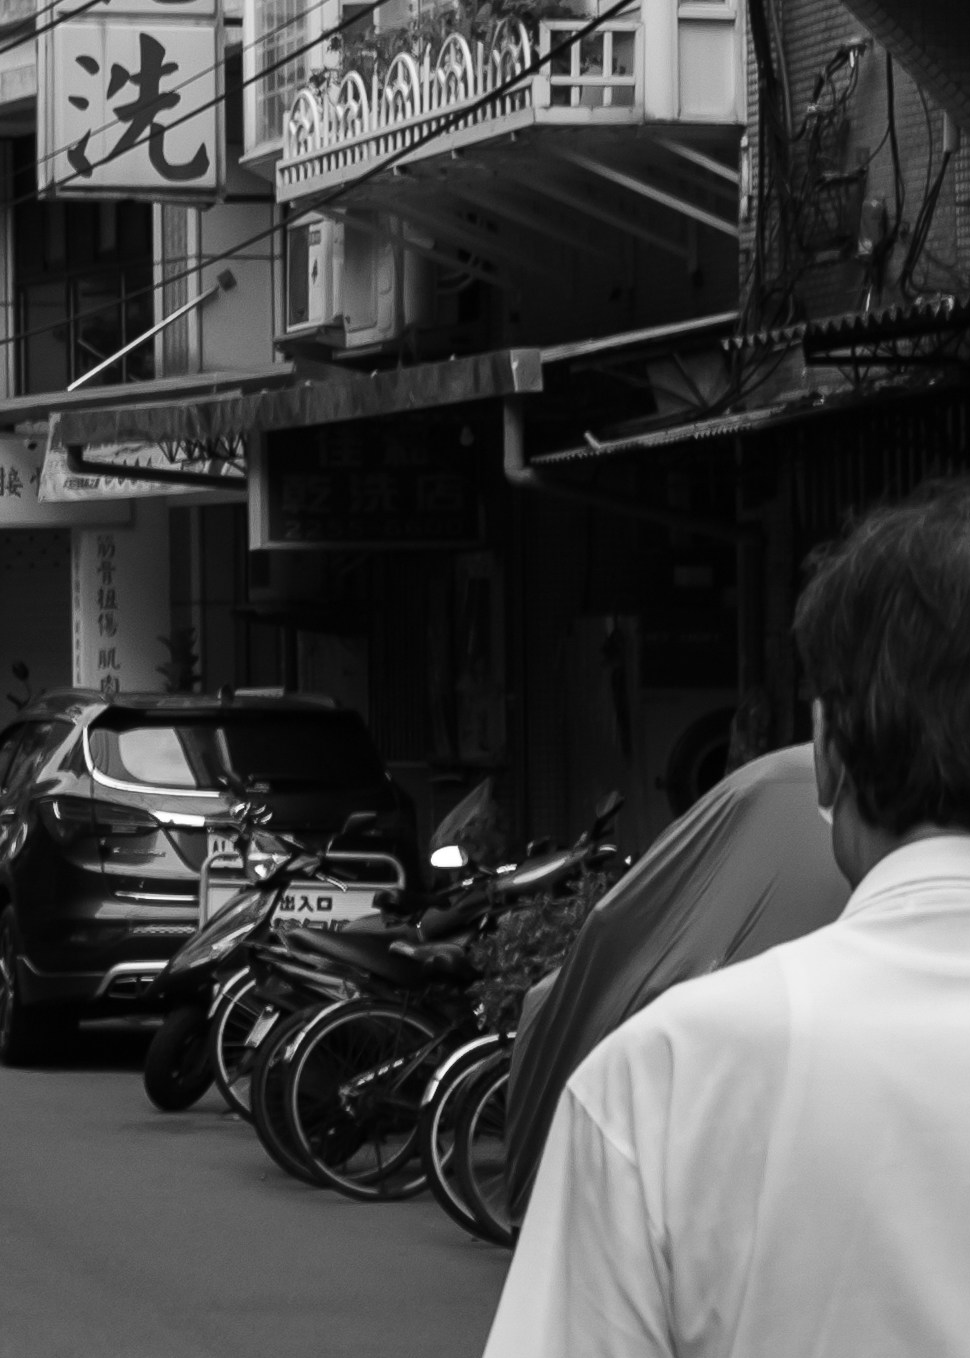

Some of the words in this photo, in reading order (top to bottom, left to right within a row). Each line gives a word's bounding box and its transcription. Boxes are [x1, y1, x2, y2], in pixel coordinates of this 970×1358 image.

[67, 32, 210, 181] 洗
[278, 895, 333, 912] 出入口
